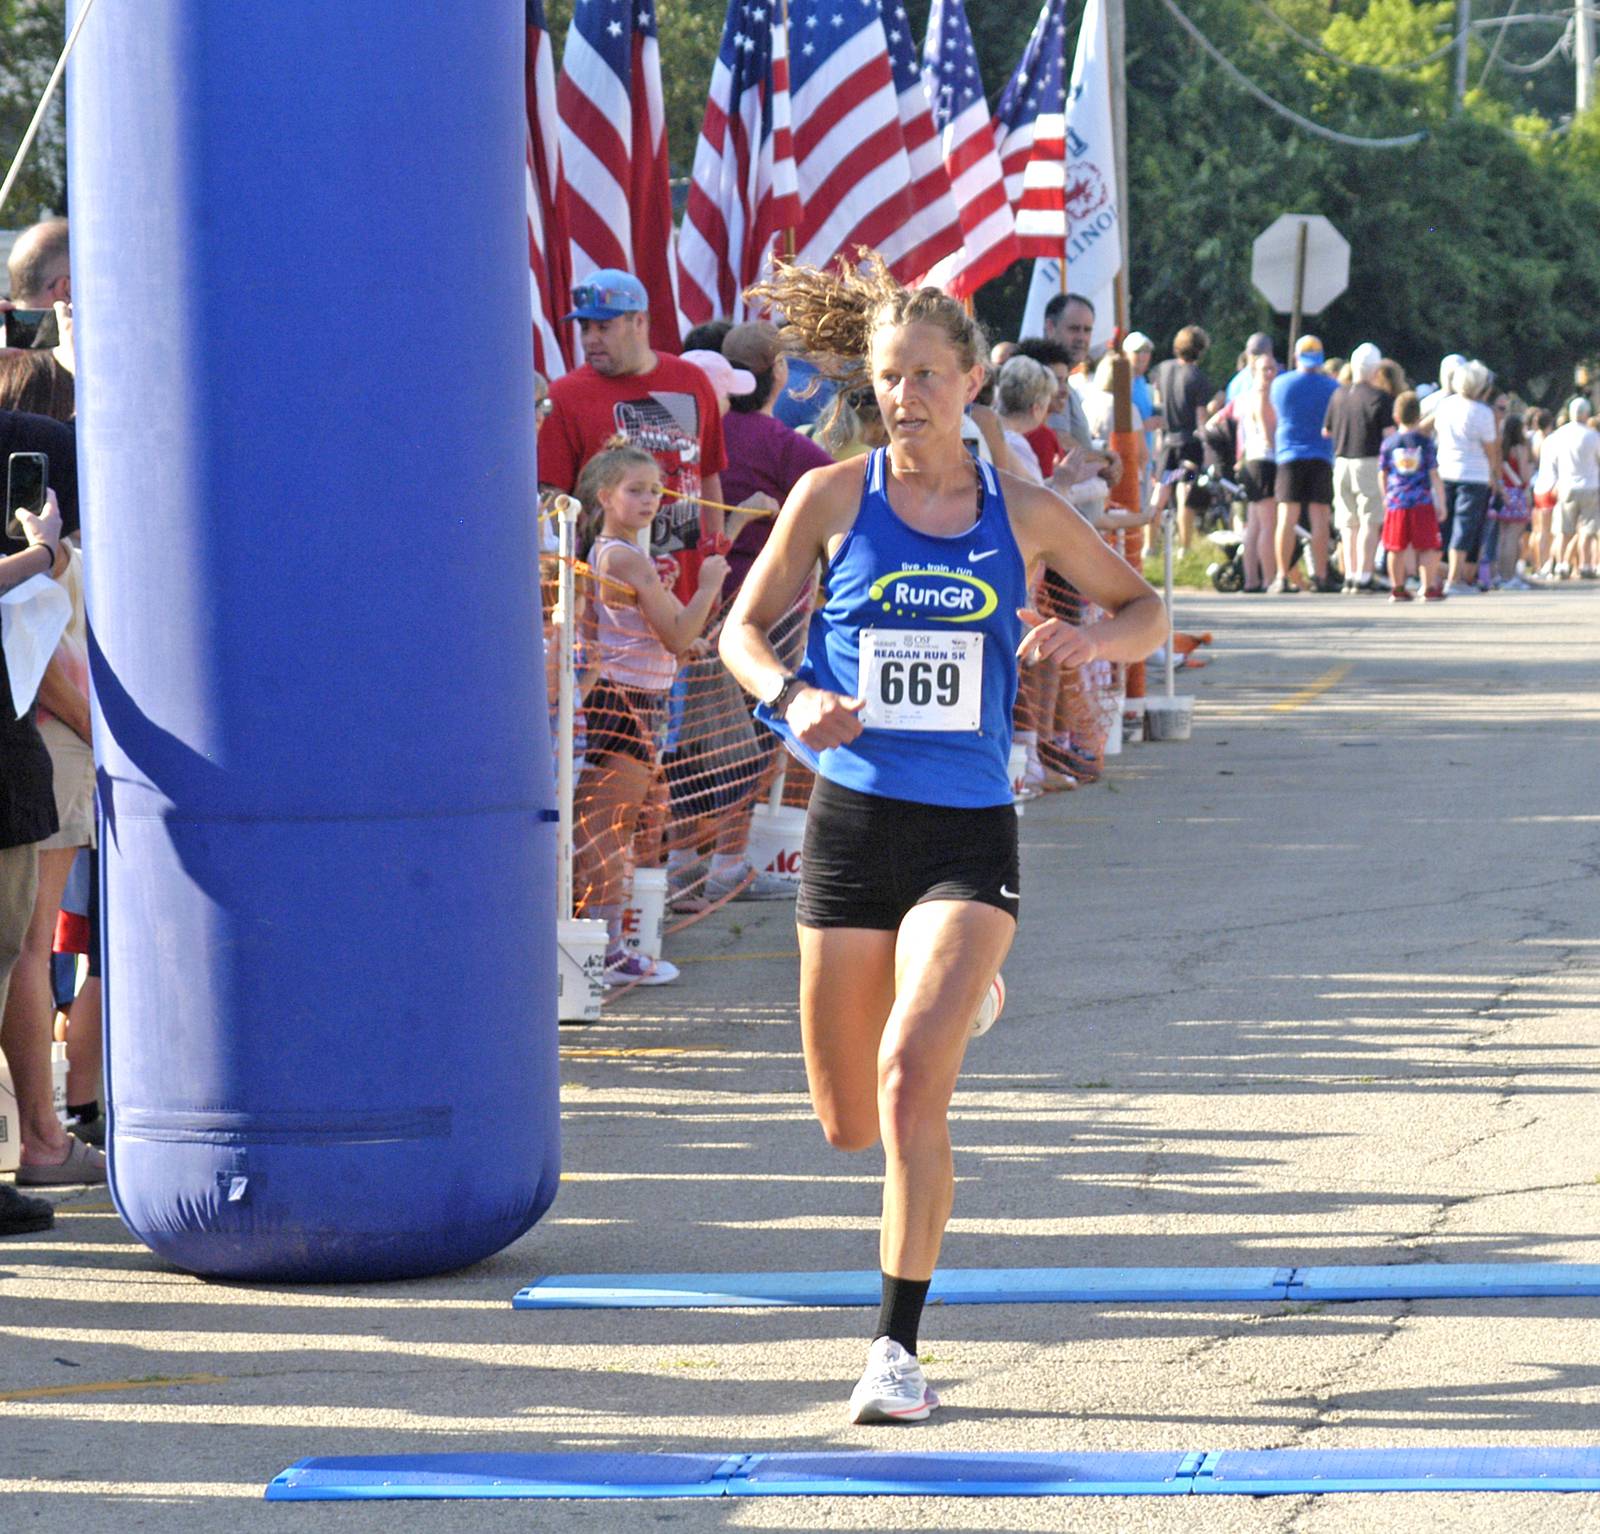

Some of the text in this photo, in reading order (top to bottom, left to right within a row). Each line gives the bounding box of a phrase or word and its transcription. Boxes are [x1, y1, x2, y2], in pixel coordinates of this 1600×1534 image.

[1041, 204, 1119, 283] ILLINOI
[901, 562, 920, 571] live
[927, 563, 949, 573] train
[895, 582, 975, 610] RunGR
[873, 649, 966, 660] REAGAN RUN 5K
[881, 661, 960, 707] 669
[765, 849, 801, 873] AC
